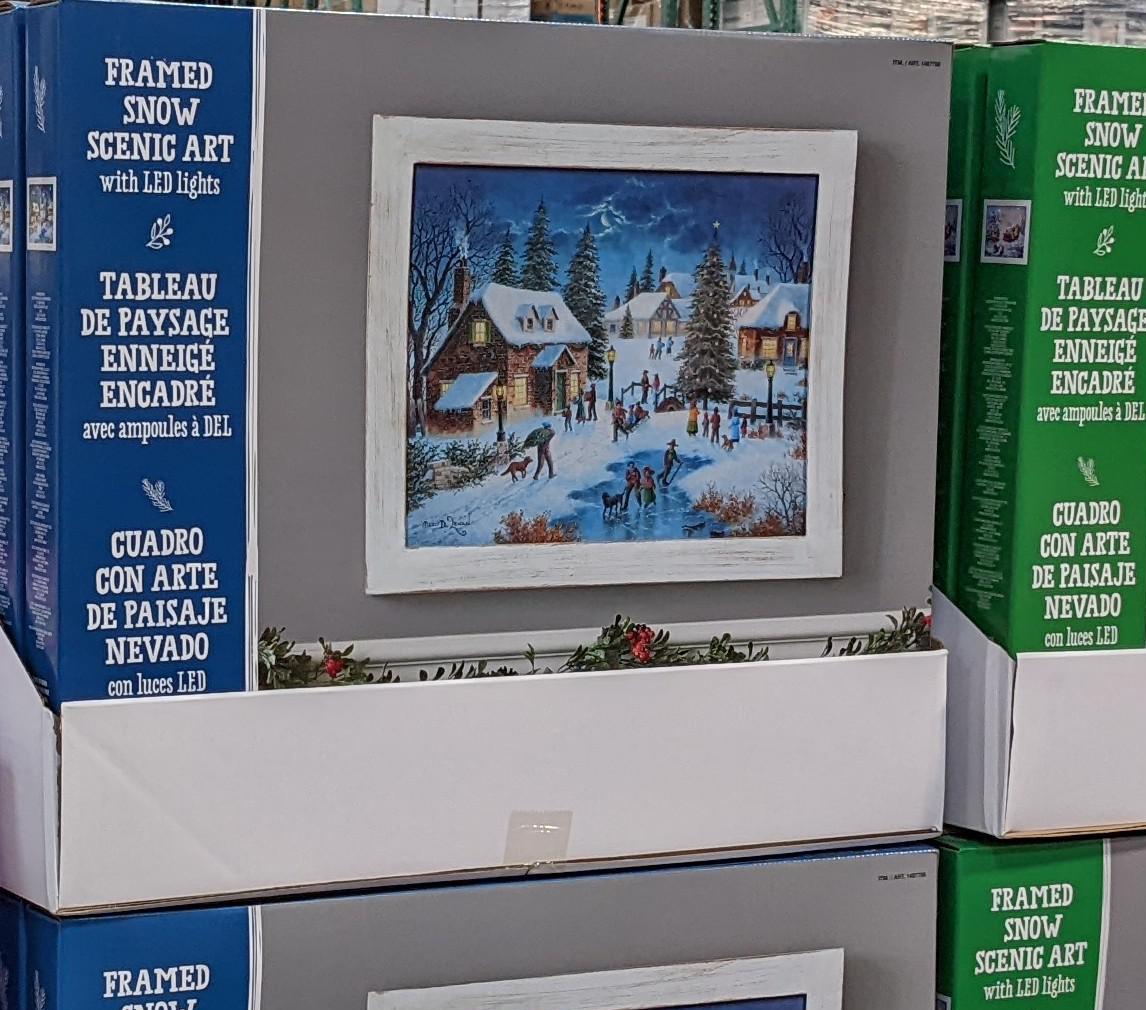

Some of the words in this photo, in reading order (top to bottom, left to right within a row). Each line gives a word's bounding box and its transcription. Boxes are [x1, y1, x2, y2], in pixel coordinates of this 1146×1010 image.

[105, 58, 213, 89] FRAMED
[123, 96, 200, 126] SNOW
[87, 131, 175, 161] SCENIC
[182, 135, 234, 163] ART
[1084, 122, 1142, 148] SNOW
[1056, 153, 1122, 180] SCENIC
[100, 171, 138, 193] with
[143, 171, 172, 194] LED
[177, 171, 220, 200] lights
[1064, 186, 1092, 207] with
[1095, 188, 1117, 208] LED
[100, 271, 217, 301] TABLEAU
[1057, 275, 1143, 301] TABLEAU
[81, 308, 111, 336] DE
[118, 308, 229, 338] PAYSAGE
[1041, 308, 1063, 331] DE
[101, 338, 215, 373] ENNEIGÉ
[1053, 338, 1136, 365] ENNEIGÉ
[101, 375, 215, 408] ENCADRÉ
[1050, 370, 1135, 395] ENCADRÉ
[1037, 407, 1061, 422] avec
[1063, 402, 1114, 427] ampoules
[1116, 406, 1122, 421] à
[1124, 402, 1146, 421] DEL
[83, 423, 115, 440] avec
[119, 415, 188, 445] ampoules
[192, 416, 200, 437] à
[204, 415, 232, 437] DEL
[1053, 500, 1120, 527] CUADRO
[111, 528, 204, 558] CUADRO
[1041, 533, 1077, 558] CON
[1080, 532, 1130, 556] ARTE
[96, 565, 144, 595] CON
[151, 563, 218, 592] ARTE
[1032, 564, 1055, 589] DE
[1058, 562, 1135, 588] PAISAJE
[87, 603, 117, 631] DE
[124, 597, 227, 629] PAISAJE
[1044, 593, 1121, 620] NEVADO
[106, 633, 208, 665] NEVADO
[1045, 633, 1064, 648] con
[1067, 627, 1093, 647] luces
[1096, 626, 1117, 645] LED
[108, 679, 132, 697] con
[137, 673, 173, 695] luces
[178, 671, 206, 692] LED
[991, 884, 1074, 911] FRAMED
[1004, 914, 1064, 943] SNOW
[975, 946, 1044, 975] SCENIC
[1047, 942, 1087, 968] ART
[104, 964, 210, 997] FRAMED
[984, 979, 1013, 1000] with
[1016, 978, 1039, 997] LED
[1042, 975, 1075, 999] lights
